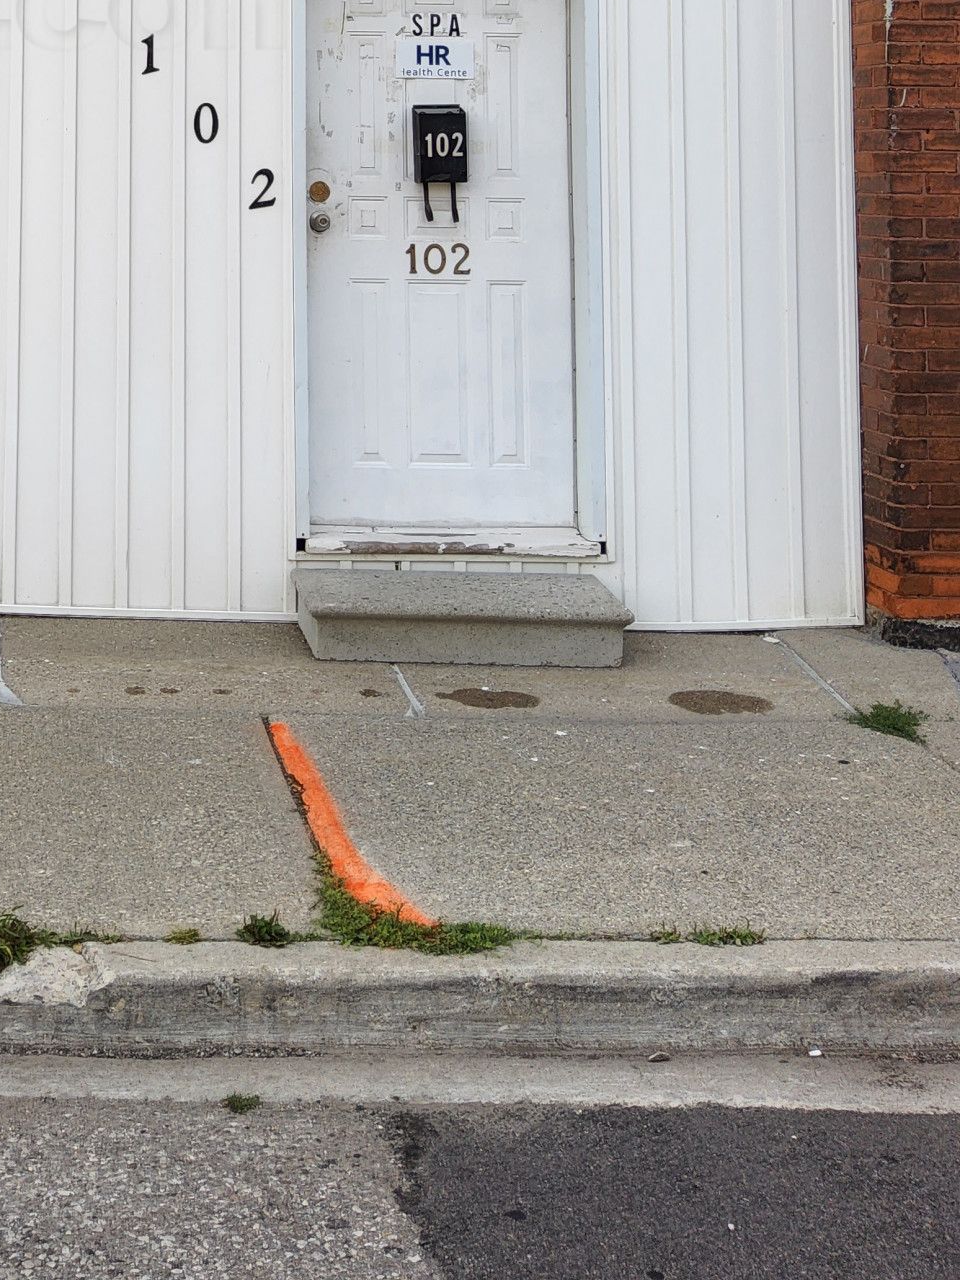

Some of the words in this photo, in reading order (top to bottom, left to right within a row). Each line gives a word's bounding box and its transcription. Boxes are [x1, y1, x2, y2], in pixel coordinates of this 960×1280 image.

[411, 12, 462, 38] SPA
[415, 43, 452, 67] HR
[424, 131, 465, 159] 102
[404, 242, 472, 276] 102
